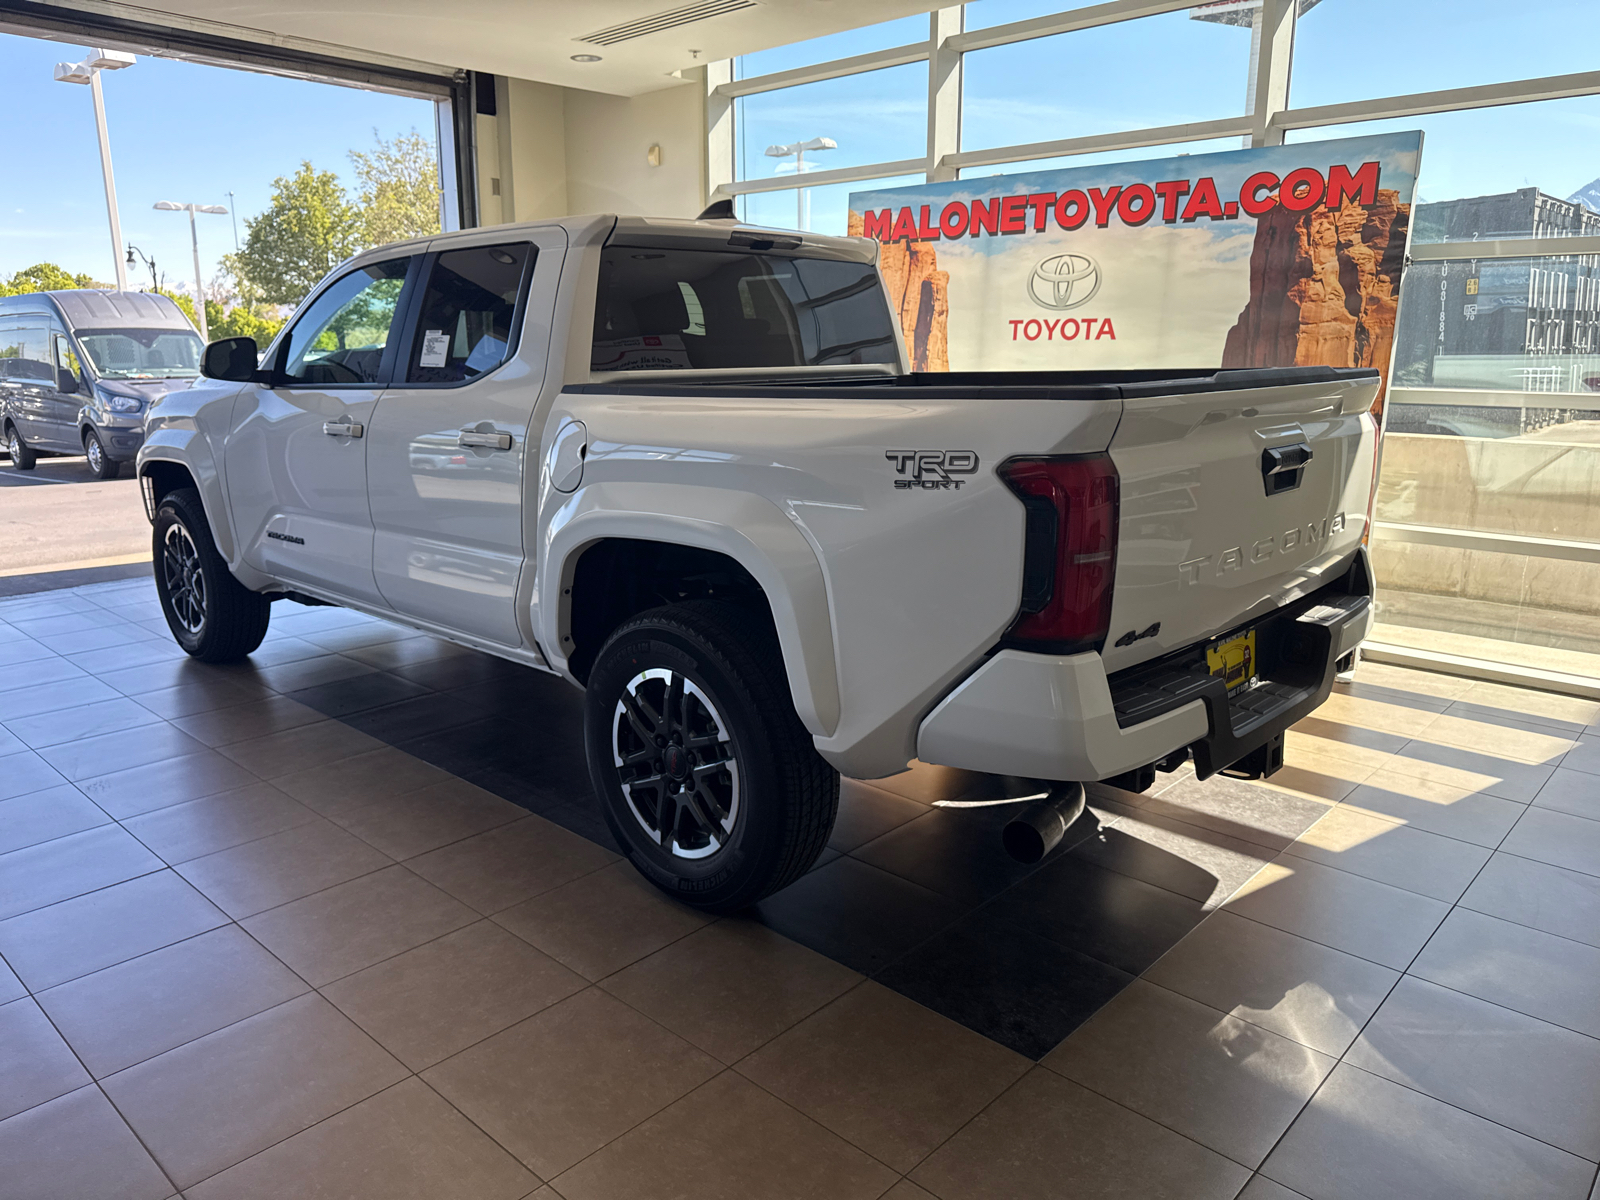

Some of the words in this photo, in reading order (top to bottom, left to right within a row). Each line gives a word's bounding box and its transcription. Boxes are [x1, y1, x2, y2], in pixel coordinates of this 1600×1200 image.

[862, 161, 1380, 244] MALONETOYOTA.COM
[1009, 318, 1116, 341] TOYOTA
[885, 450, 980, 481] TRD
[894, 480, 966, 490] SPORT
[1178, 511, 1346, 586] TACOMA
